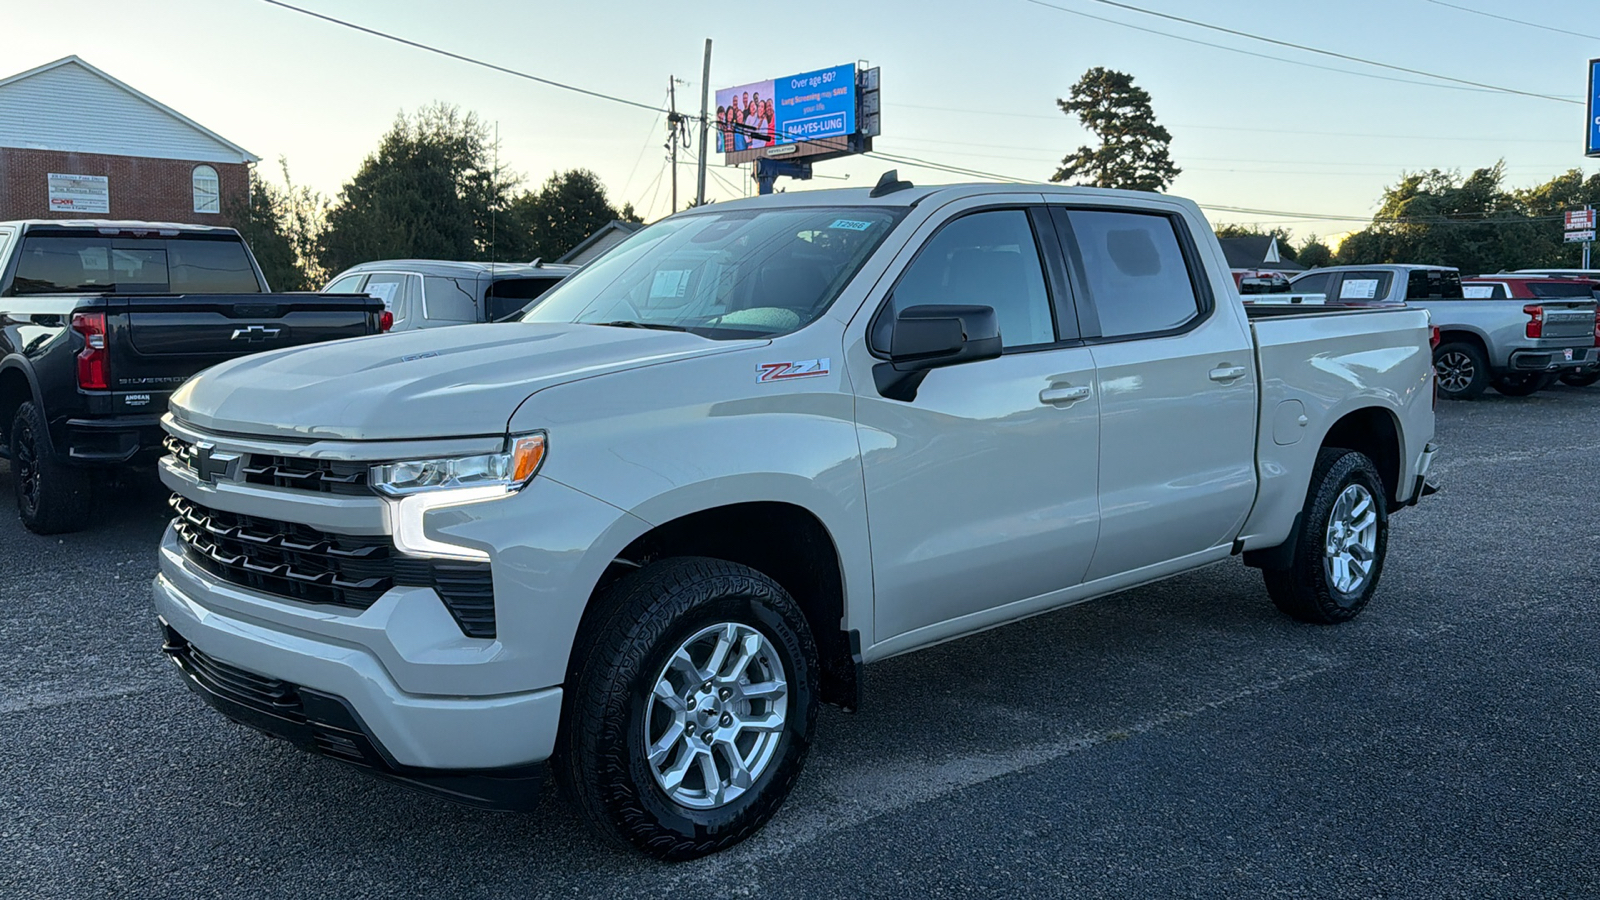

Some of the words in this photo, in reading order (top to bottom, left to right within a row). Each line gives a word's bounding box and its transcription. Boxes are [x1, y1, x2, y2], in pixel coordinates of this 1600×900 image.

[791, 79, 808, 89] Over
[808, 76, 822, 88] age
[822, 71, 836, 83] 50?
[781, 98, 794, 106] Lung
[794, 93, 820, 103] Screening
[832, 86, 848, 96] SAVE
[788, 118, 842, 135] 844-YES-LUNG
[756, 358, 829, 383] Z71
